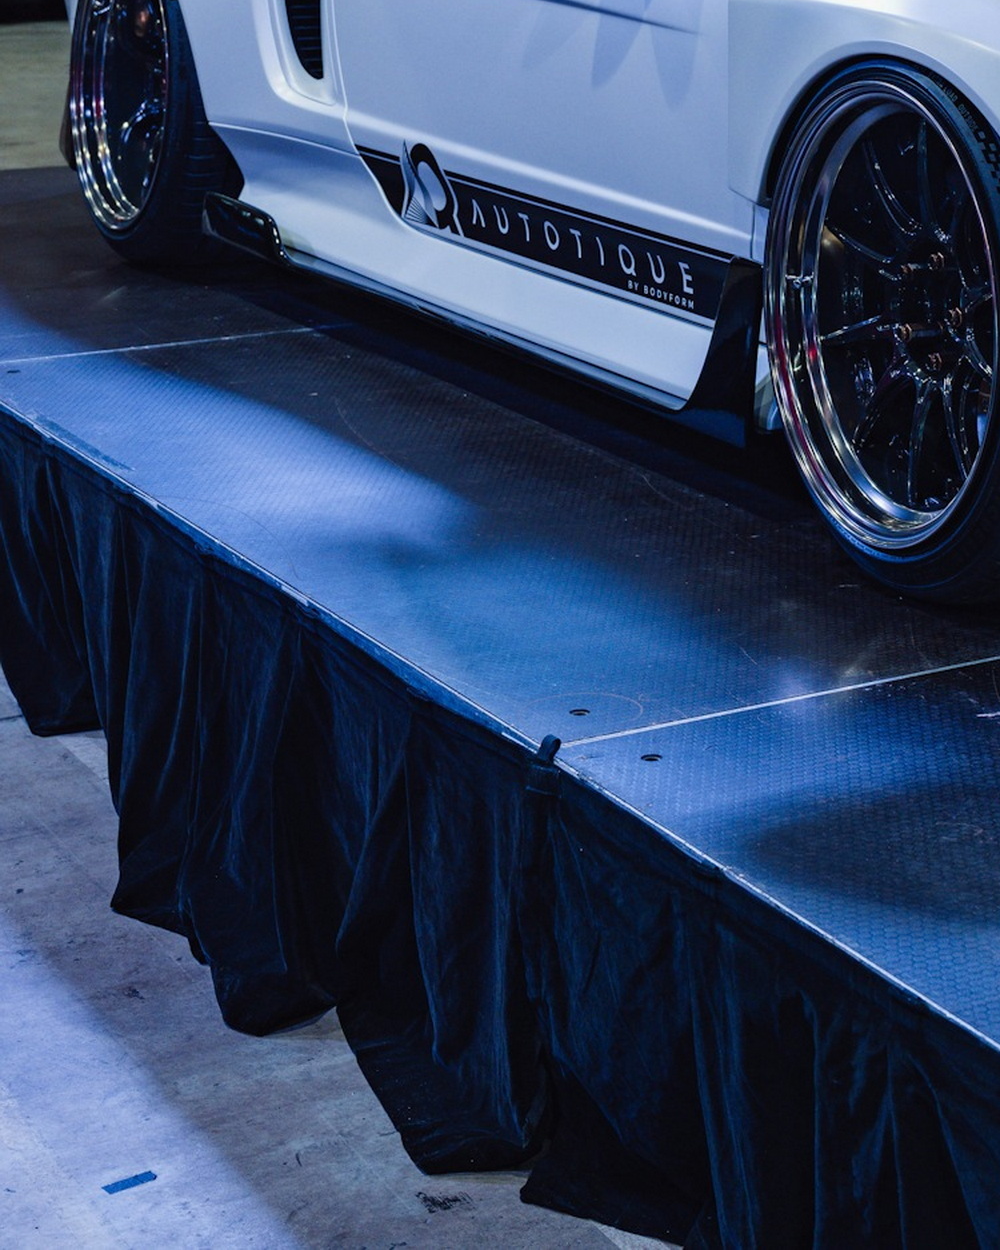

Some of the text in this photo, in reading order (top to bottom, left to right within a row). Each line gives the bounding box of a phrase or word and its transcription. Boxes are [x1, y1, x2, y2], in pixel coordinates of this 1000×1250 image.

[472, 199, 694, 295] AUTOTIQUE
[627, 280, 695, 310] BY BODYFORM
